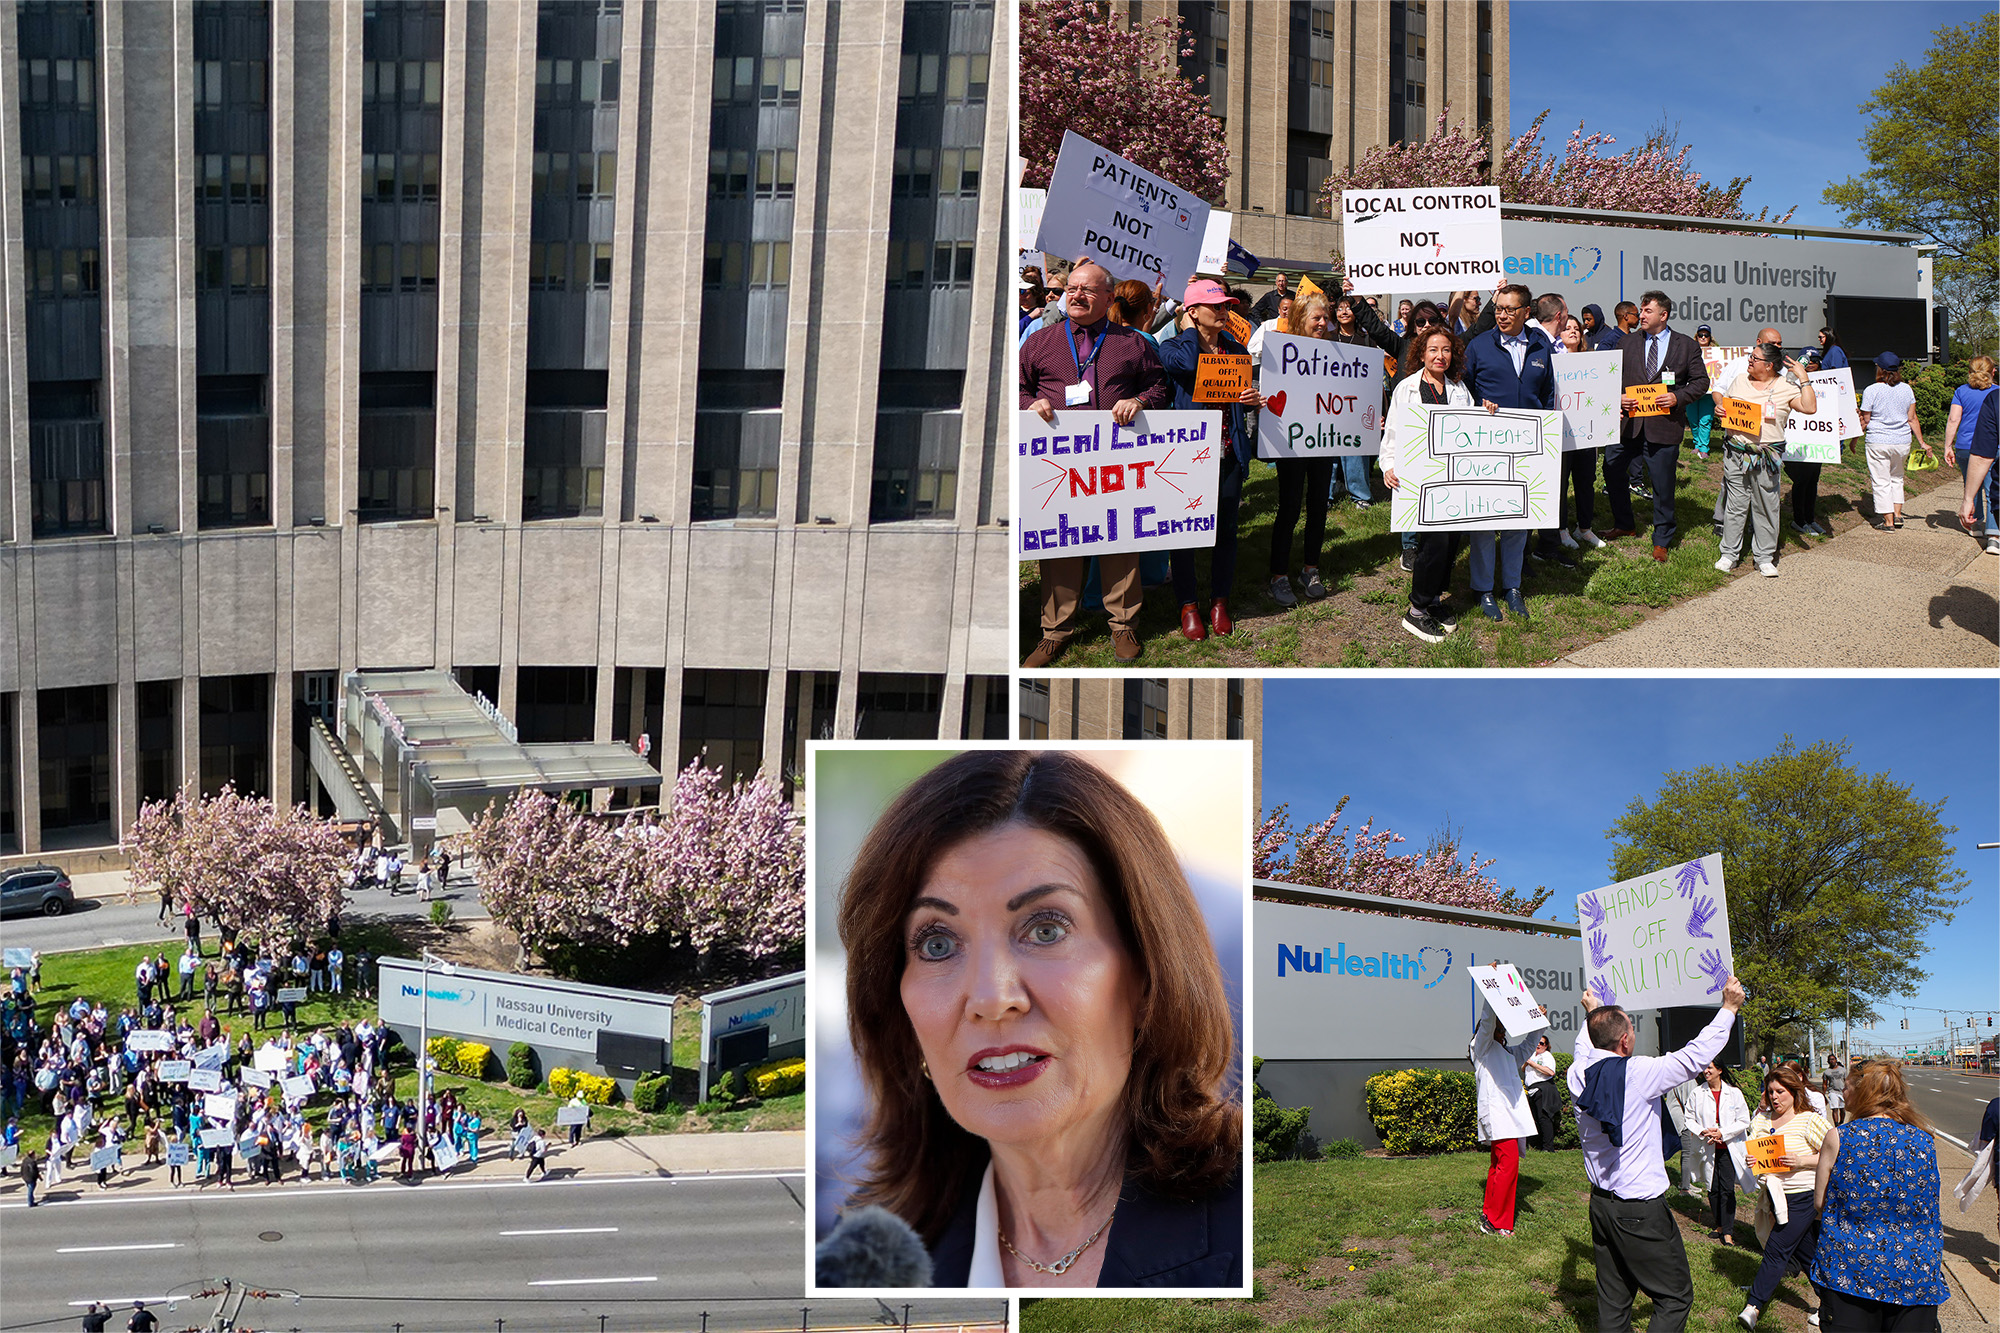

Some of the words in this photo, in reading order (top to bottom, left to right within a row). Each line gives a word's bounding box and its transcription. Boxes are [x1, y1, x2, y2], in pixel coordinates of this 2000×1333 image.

[1092, 156, 1178, 210] PATIENTS
[1345, 197, 1406, 213] LOCAL
[1412, 194, 1496, 210] CONTROL
[1112, 210, 1153, 239] NOT
[1084, 229, 1163, 273] POLITICS
[1400, 232, 1440, 247] NOT
[1424, 260, 1501, 276] CONTROL
[1503, 252, 1570, 276] ealth
[1643, 255, 1727, 283] Nassau
[1733, 260, 1837, 294] University
[1668, 296, 1732, 322] edical
[1739, 297, 1808, 324] Center
[1201, 357, 1229, 365] ALBANY
[1235, 357, 1252, 366] BACK
[1218, 368, 1238, 376] OFF!!
[1282, 342, 1369, 378] Patients
[1202, 379, 1237, 388] QUALITY
[1556, 368, 1599, 383] tients
[1636, 386, 1656, 394] HONK
[1316, 392, 1358, 415] NOT
[1732, 401, 1752, 411] HONK
[1288, 422, 1362, 450] Politics
[1440, 414, 1534, 448] Patients
[1728, 417, 1755, 430] NUMC
[1803, 420, 1833, 432] JOBS
[1069, 460, 1155, 498] NOT
[1456, 457, 1507, 476] Over
[1426, 486, 1522, 520] Politics
[1019, 508, 1118, 554] ochul
[1603, 878, 1674, 923] HANDS
[1633, 918, 1666, 949] OFF
[1277, 942, 1419, 980] NuHealth
[1611, 946, 1702, 997] NUMC
[1482, 978, 1500, 989] SAVE
[496, 996, 543, 1014] Nassau
[547, 1003, 613, 1027] University
[1507, 996, 1522, 1007] OUR
[1527, 1008, 1542, 1019] JOBS
[496, 1014, 546, 1033] Medical
[550, 1022, 593, 1040] Center
